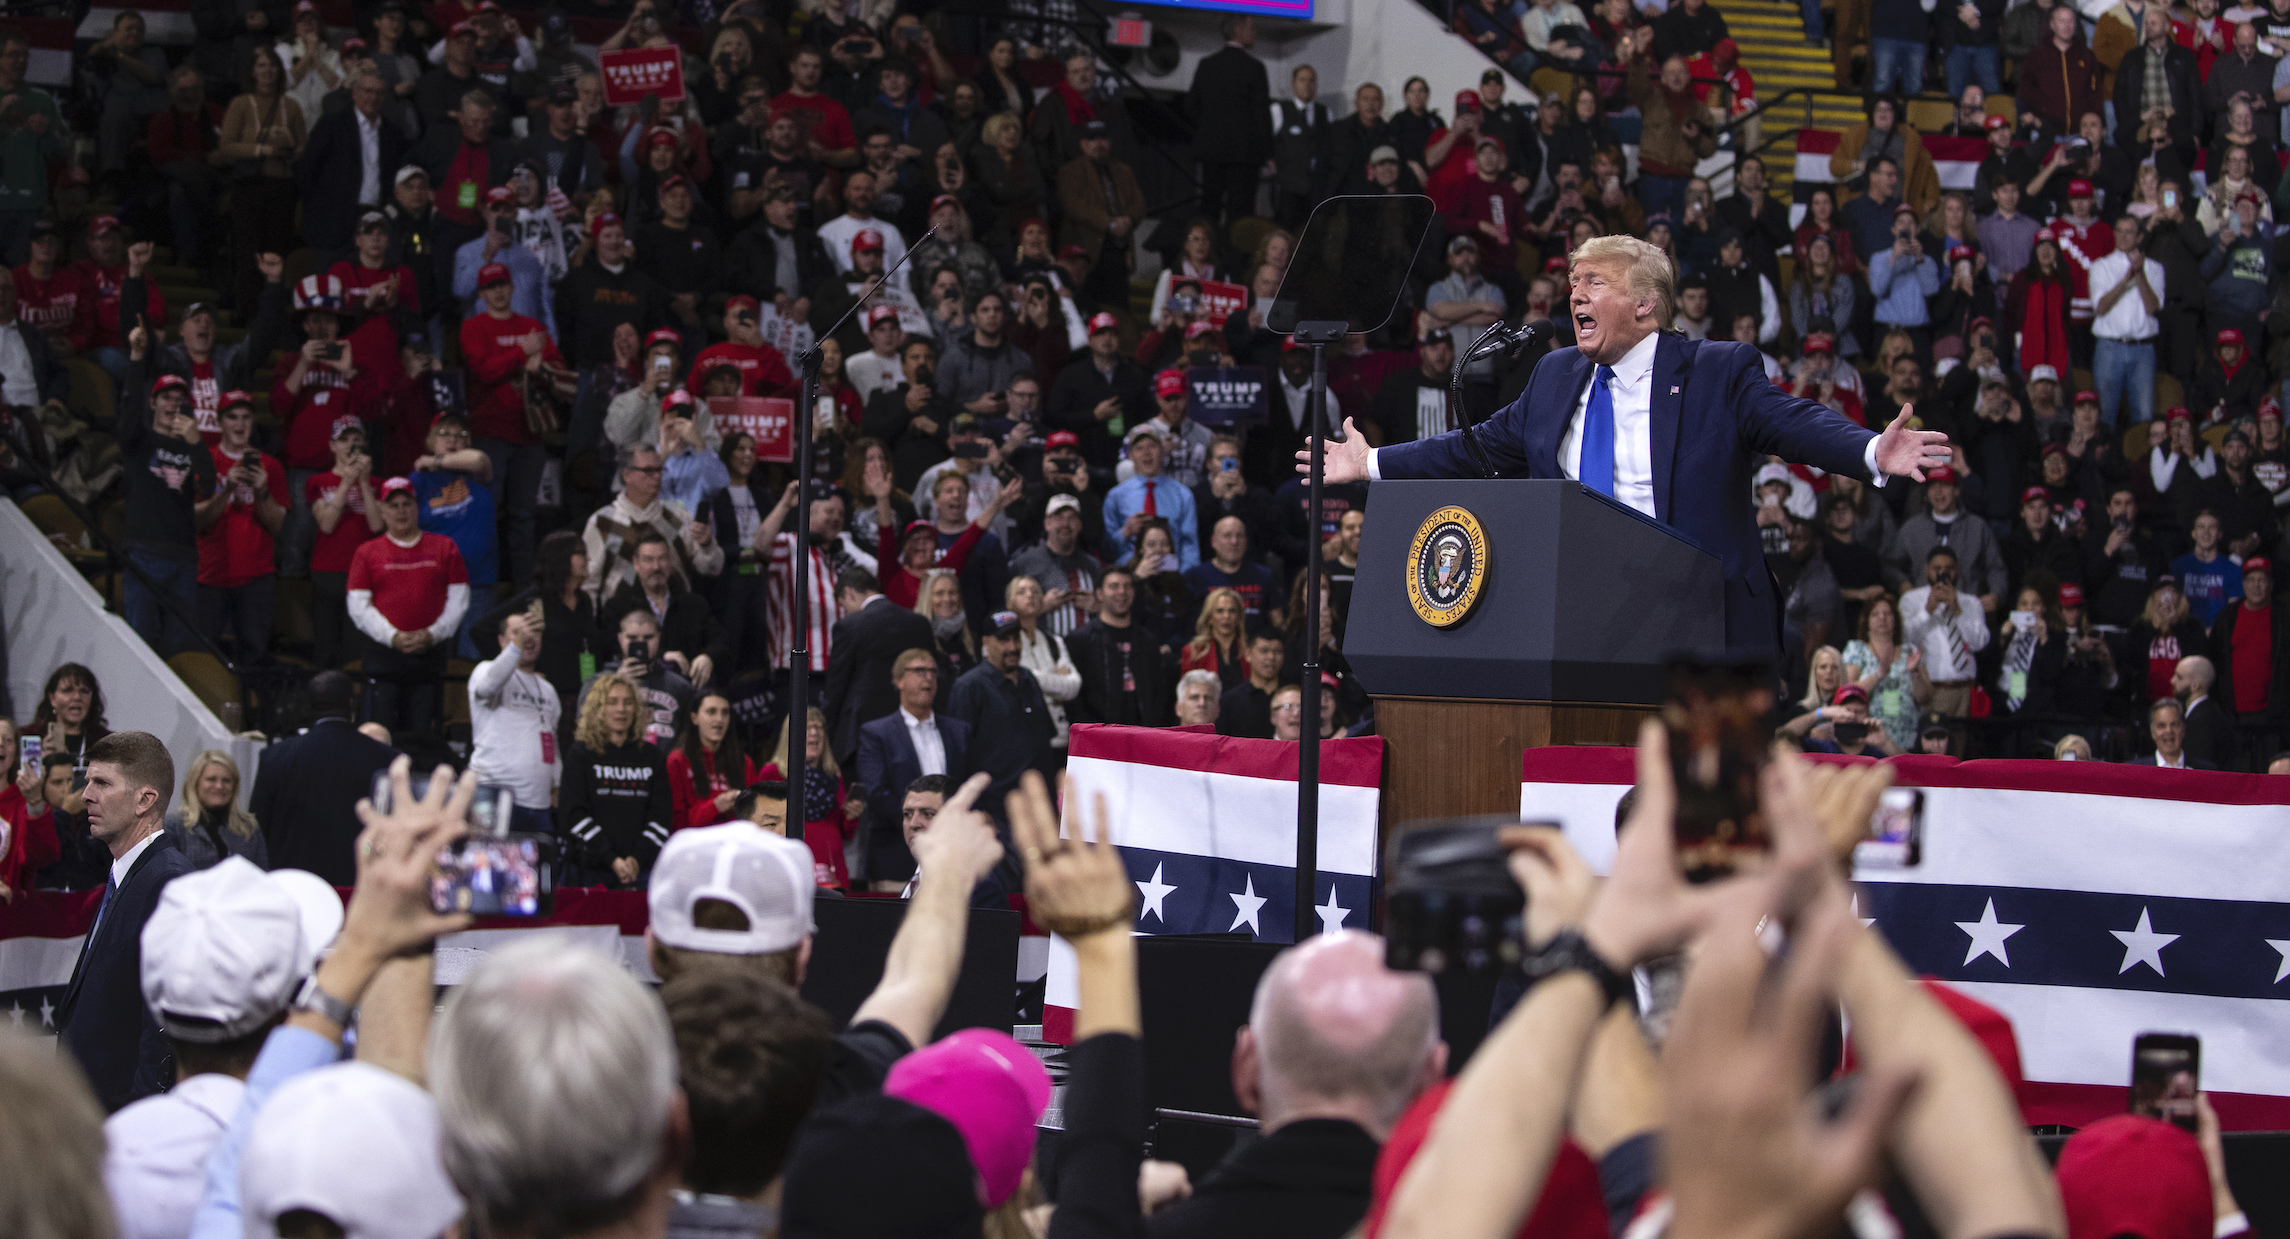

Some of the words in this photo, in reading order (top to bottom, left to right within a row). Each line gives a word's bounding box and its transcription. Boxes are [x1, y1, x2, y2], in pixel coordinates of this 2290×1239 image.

[606, 61, 676, 78] TRUMP
[1200, 294, 1242, 309] UMP
[1192, 382, 1262, 394] TRUMP
[713, 414, 788, 427] TRUMP
[1453, 512, 1462, 520] OF
[1462, 515, 1472, 528] THE
[1411, 510, 1452, 560] PRESIDENT
[1471, 527, 1483, 577] UNITED
[1411, 583, 1417, 594] OF
[1414, 594, 1433, 620] SEAL
[1446, 586, 1476, 622] STATES
[592, 764, 654, 781] TRUMP
